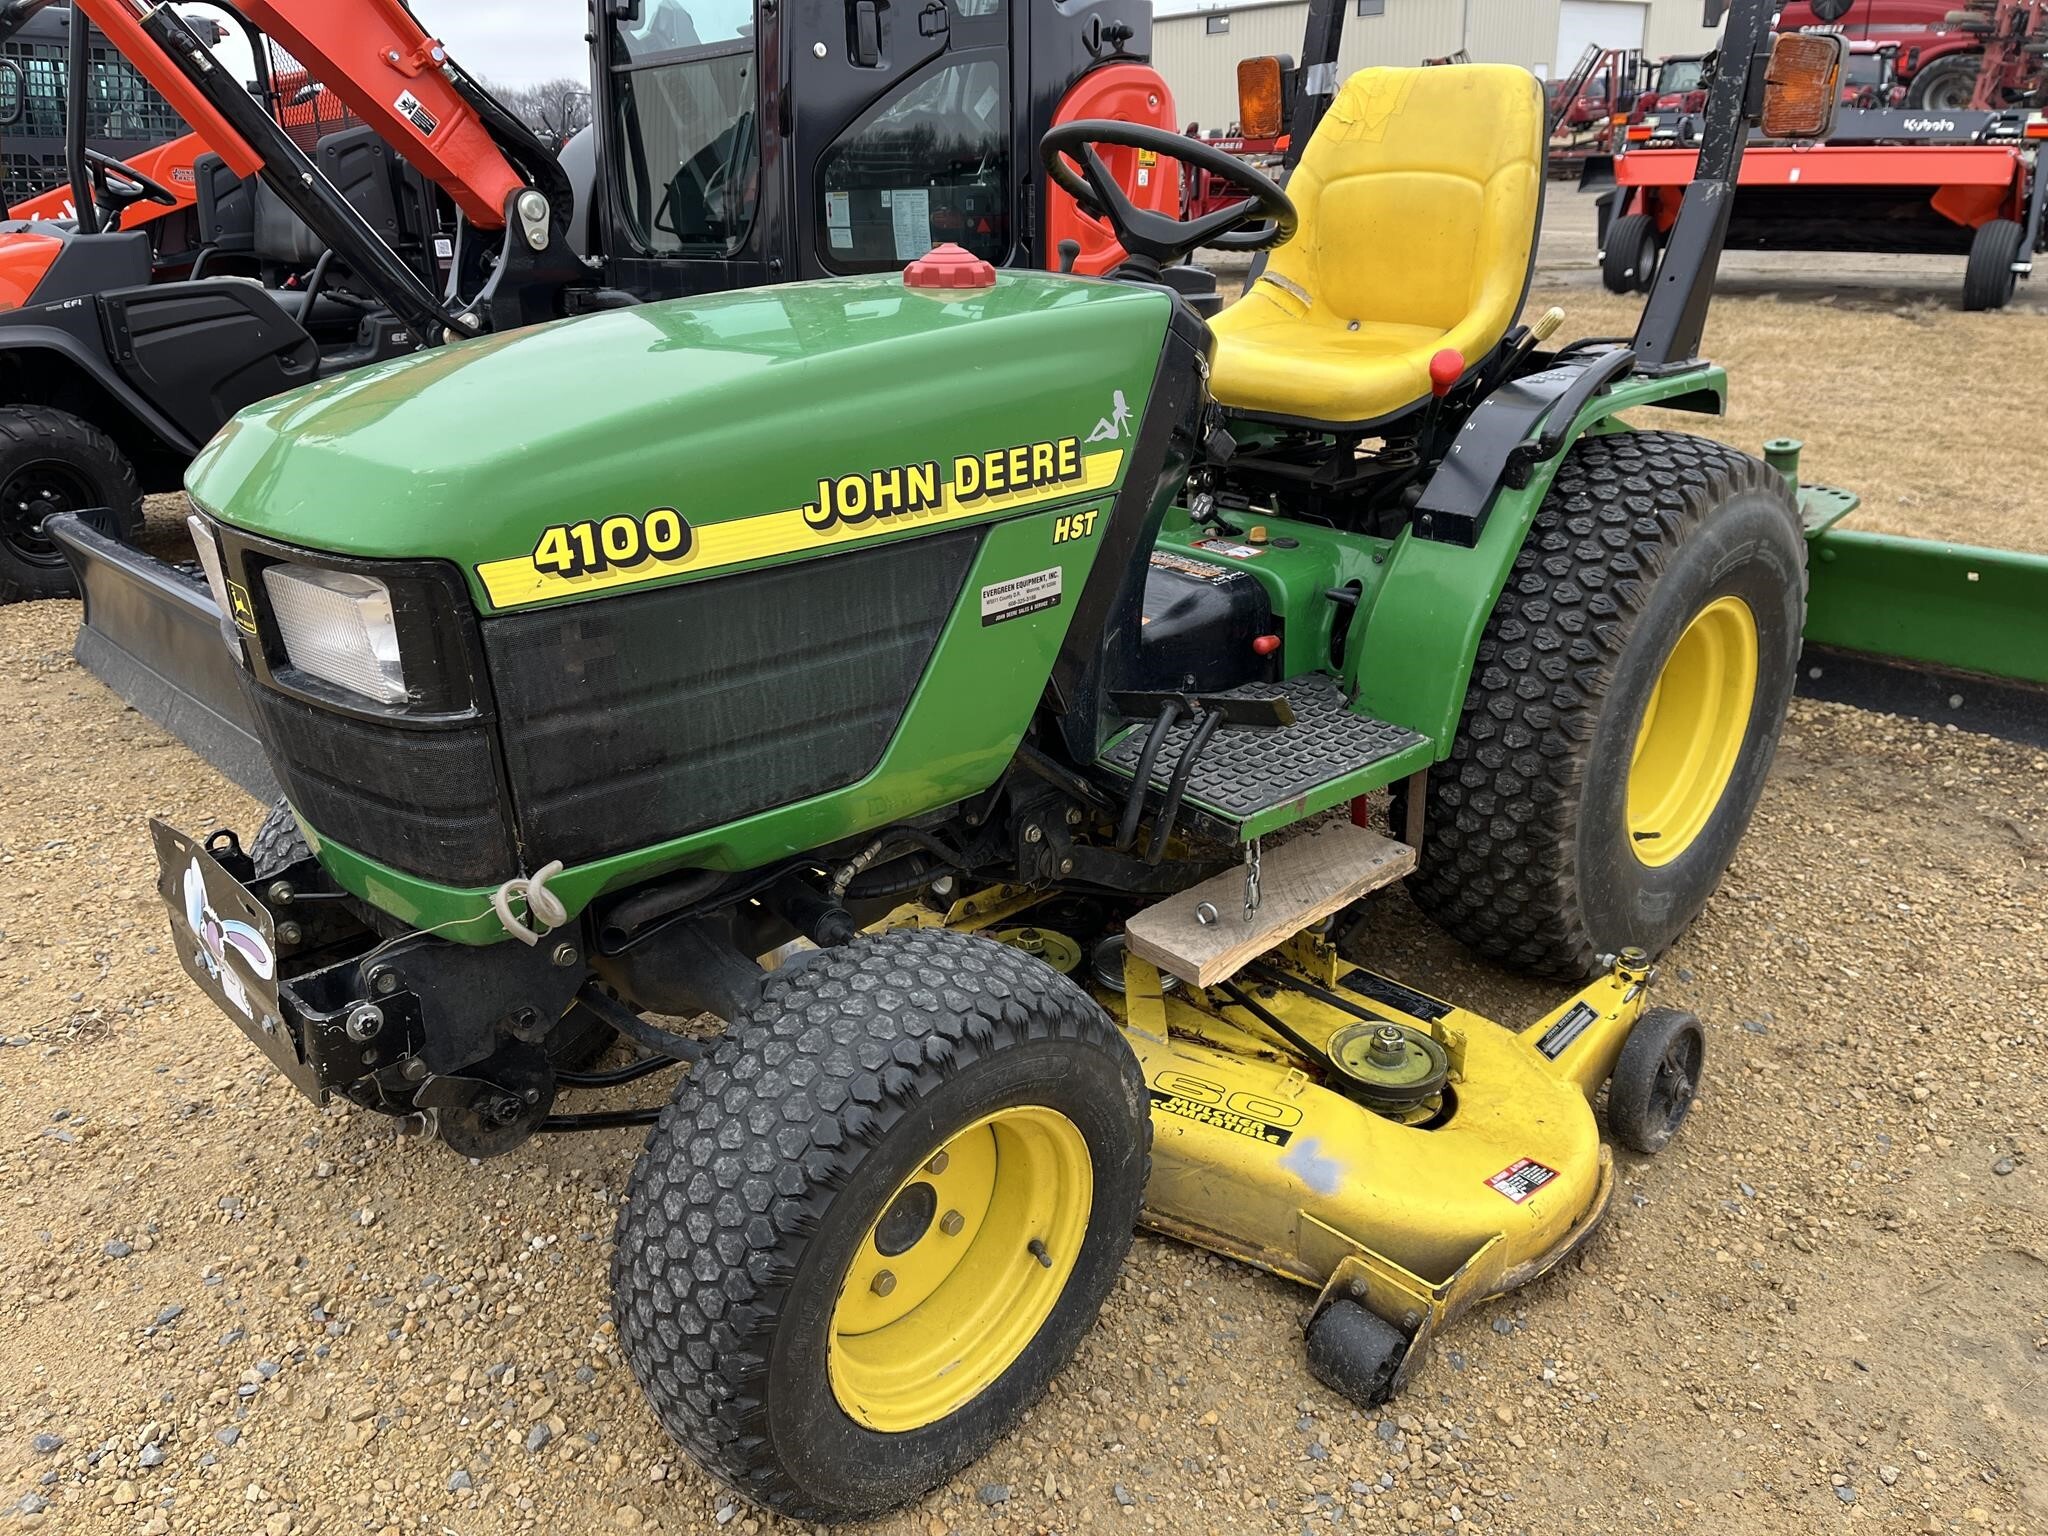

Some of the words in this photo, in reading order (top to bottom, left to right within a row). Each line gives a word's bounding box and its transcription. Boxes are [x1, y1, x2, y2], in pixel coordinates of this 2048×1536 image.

[1903, 118, 1955, 131] Kubota
[803, 462, 939, 528] JOHN
[954, 437, 1080, 499] DEERE
[532, 507, 691, 578] 4100
[1053, 509, 1099, 545] HST
[983, 583, 1015, 598] EVERGREEN
[1016, 574, 1048, 589] EQUIPMENT,
[1048, 571, 1060, 580] INC.
[1154, 1071, 1303, 1127] 60
[1169, 1097, 1266, 1132] MULCHER
[1150, 1098, 1280, 1144] COMPATIBLE
